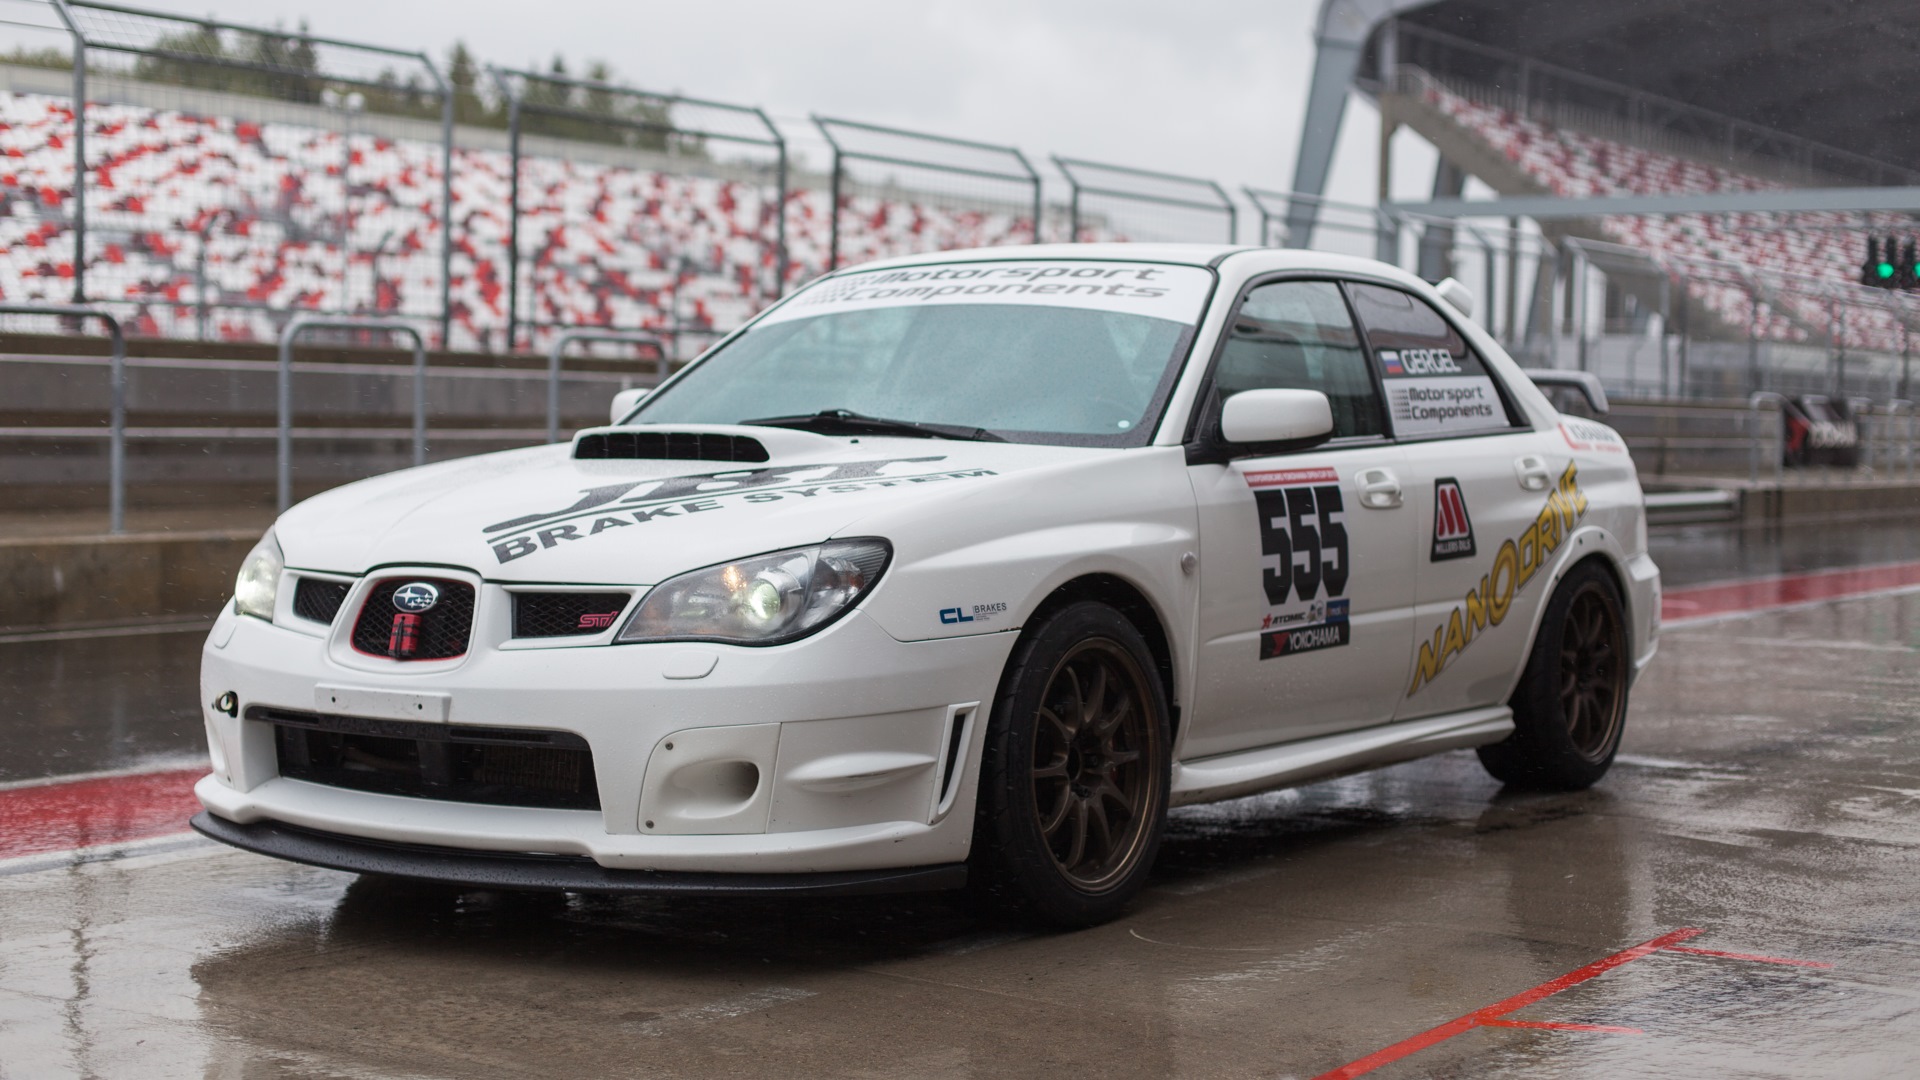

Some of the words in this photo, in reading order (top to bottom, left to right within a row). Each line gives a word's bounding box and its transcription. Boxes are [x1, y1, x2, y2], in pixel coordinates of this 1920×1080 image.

[870, 267, 1165, 284] Motorsport
[843, 281, 1170, 301] Components
[1409, 386, 1485, 404] Motorsport
[1412, 402, 1493, 423] Components
[492, 499, 725, 565] BRAKE
[743, 468, 999, 503] SYSTEM
[1253, 485, 1350, 606] 555
[1407, 459, 1589, 699] NANODRIVE
[939, 607, 974, 624] CL
[974, 602, 1007, 613] BRAKES
[1272, 612, 1305, 625] ATOMIC
[1289, 626, 1340, 651] YOKOHAMA
